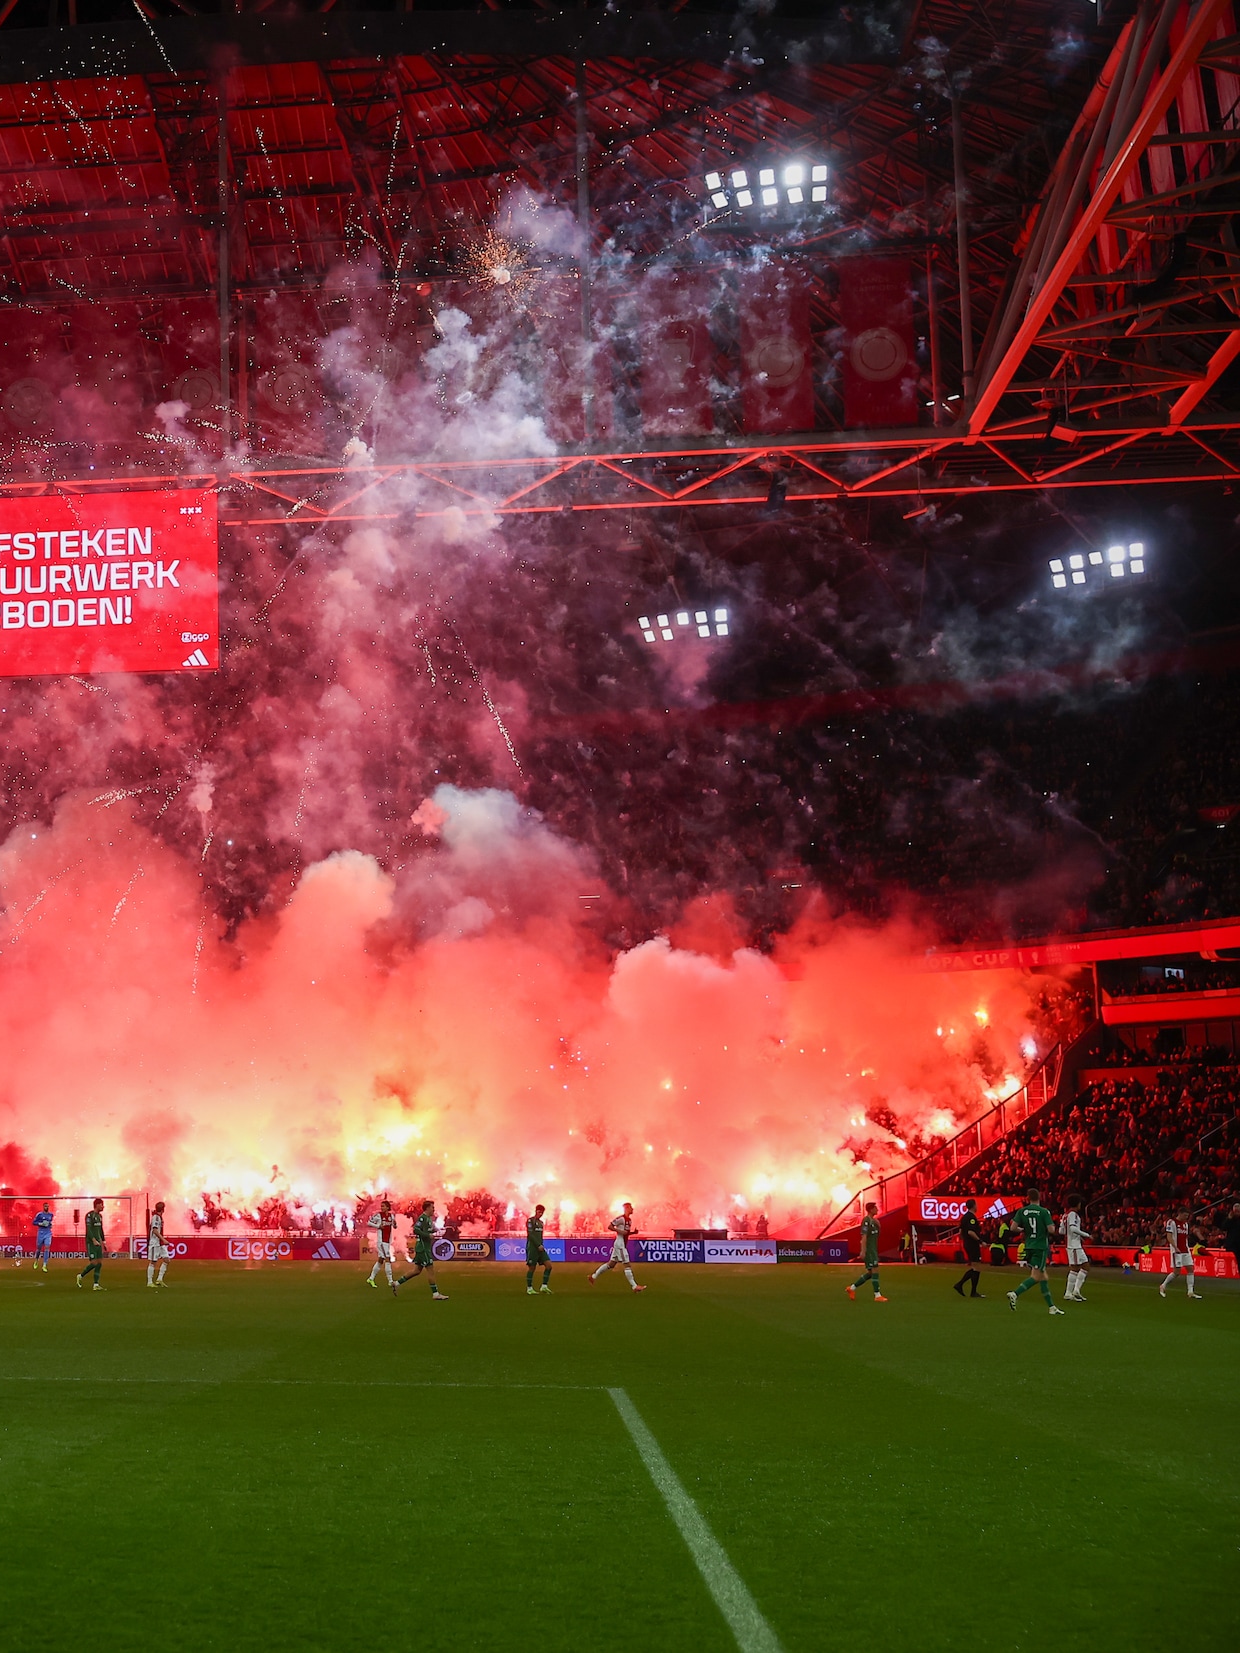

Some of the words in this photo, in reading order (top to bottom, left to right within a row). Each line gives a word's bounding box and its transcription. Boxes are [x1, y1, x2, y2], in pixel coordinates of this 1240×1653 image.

[972, 953, 1010, 967] CUP
[1028, 1217, 1037, 1233] 4
[639, 1241, 701, 1251] VRIENDEN
[647, 1251, 694, 1262] LOTERIJ
[707, 1248, 774, 1257] OLYMPIA
[778, 1247, 814, 1257] Heineken
